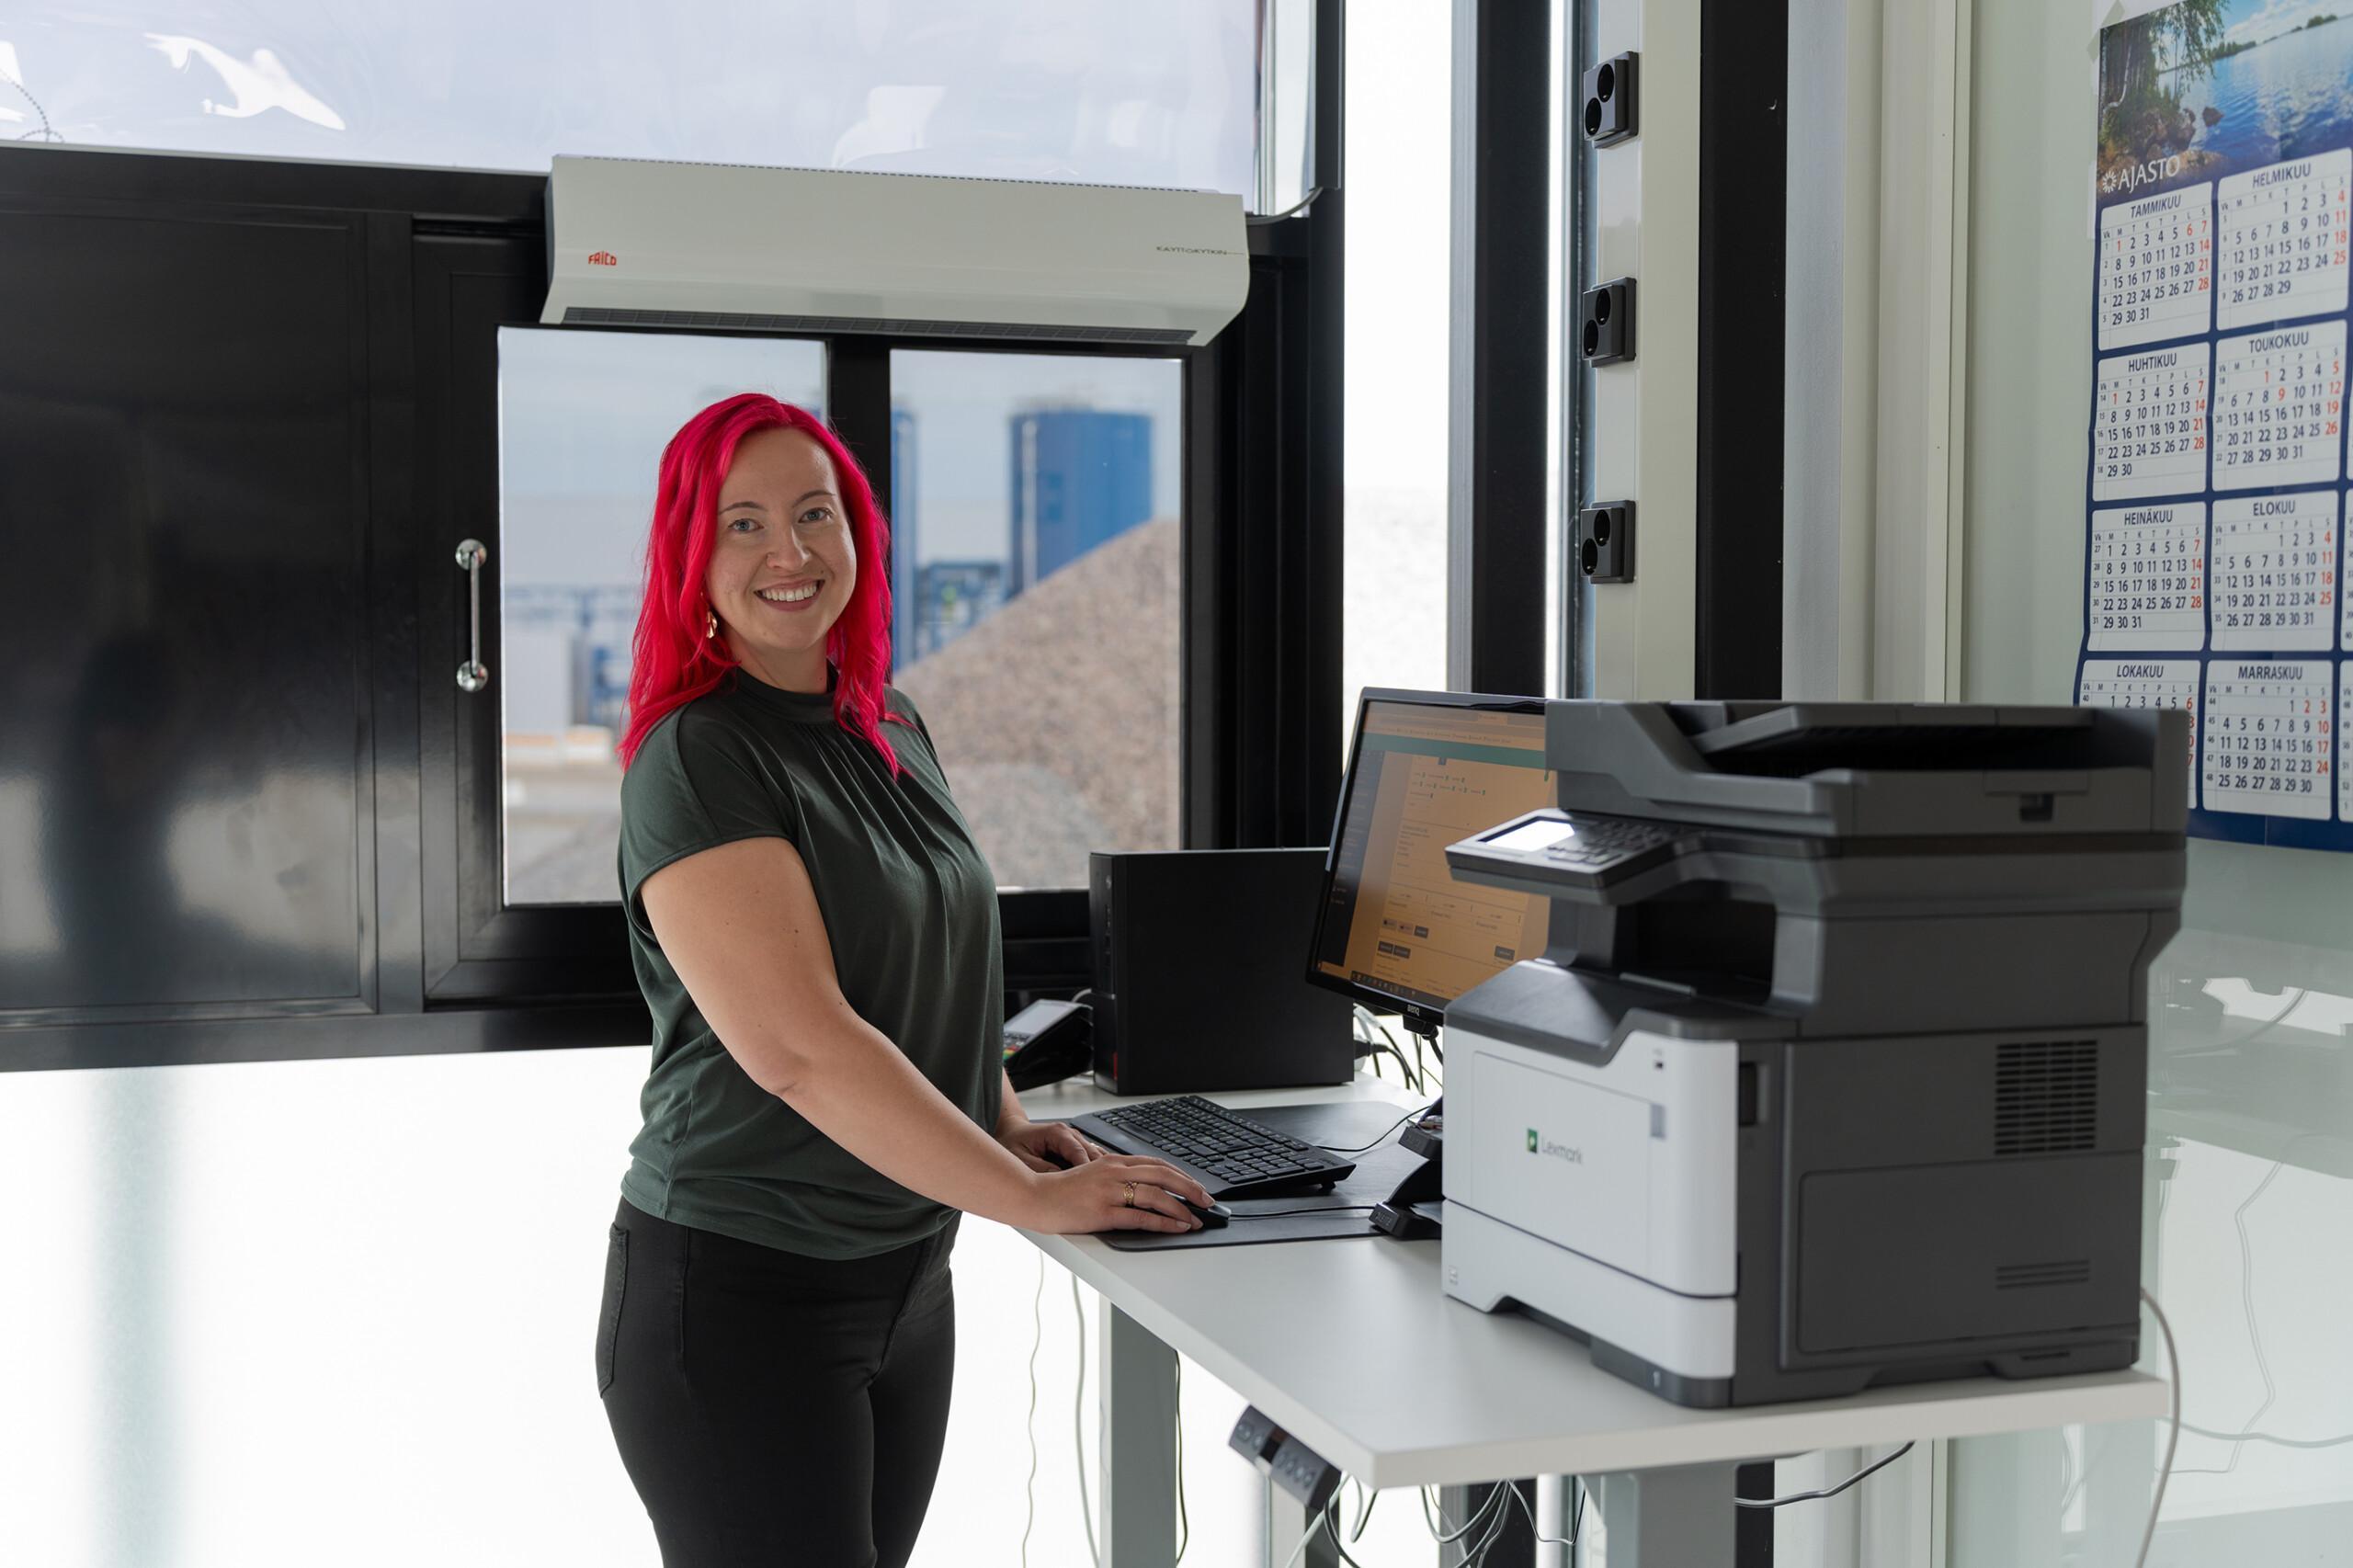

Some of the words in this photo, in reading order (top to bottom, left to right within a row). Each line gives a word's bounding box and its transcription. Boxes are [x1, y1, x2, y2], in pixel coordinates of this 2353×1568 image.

[2118, 154, 2179, 194] AJASTO
[2253, 163, 2311, 188] HELMIKUU
[2131, 195, 2180, 218] TAMMIKUU
[2118, 240, 2120, 252] 1
[2131, 237, 2135, 249] 2
[2144, 233, 2149, 246] 3
[2158, 231, 2164, 242] 4
[2173, 227, 2177, 240] 5
[2187, 223, 2193, 236] 6
[2202, 220, 2207, 233] 7
[2279, 240, 2291, 254] 15
[2299, 237, 2310, 250] 16
[2316, 233, 2328, 247] 17
[2335, 230, 2347, 244] 18
[2116, 258, 2121, 270] 8
[2130, 256, 2135, 267] 9
[2142, 252, 2152, 265] 10
[2156, 248, 2165, 261] 11
[2171, 245, 2180, 258] 12
[2185, 242, 2195, 256] 13
[2200, 239, 2210, 252] 14
[2114, 276, 2123, 289] 15
[2128, 273, 2137, 286] 16
[2142, 270, 2151, 283] 17
[2156, 267, 2165, 279] 18
[2170, 264, 2180, 277] 19
[2184, 261, 2195, 275] 20
[2199, 258, 2208, 272] 21
[2113, 294, 2122, 307] 22
[2127, 291, 2136, 304] 23
[2141, 289, 2151, 301] 24
[2154, 286, 2165, 299] 25
[2169, 283, 2179, 296] 26
[2184, 279, 2194, 293] 27
[2199, 277, 2209, 290] 28
[2112, 312, 2122, 325] 29
[2126, 310, 2136, 323] 30
[2140, 307, 2149, 320] 31
[2249, 332, 2309, 353] TOUKOKUU
[2129, 353, 2177, 372] HUHTIKUU
[2113, 393, 2117, 404] 1
[2126, 391, 2131, 403] 2
[2141, 389, 2145, 401] 3
[2154, 387, 2160, 398] 4
[2169, 384, 2174, 397] 5
[2183, 382, 2188, 395] 6
[2199, 381, 2204, 392] 7
[2111, 411, 2116, 423] 8
[2125, 409, 2131, 421] 9
[2138, 407, 2147, 419] 10
[2152, 405, 2160, 417] 11
[2166, 403, 2176, 415] 12
[2181, 401, 2190, 414] 13
[2196, 399, 2205, 412] 14
[2109, 428, 2118, 441] 15
[2122, 426, 2132, 439] 16
[2136, 425, 2145, 437] 17
[2150, 423, 2160, 436] 18
[2165, 421, 2175, 434] 19
[2178, 419, 2189, 432] 20
[2193, 417, 2202, 431] 21
[2228, 432, 2238, 446] 20
[2243, 431, 2252, 444] 21
[2258, 429, 2270, 442] 22
[2277, 426, 2287, 440] 23
[2293, 425, 2304, 438] 24
[2309, 423, 2320, 437] 25
[2325, 421, 2337, 435] 26
[2109, 447, 2118, 459] 22
[2122, 445, 2131, 458] 23
[2136, 444, 2146, 456] 24
[2151, 441, 2160, 454] 25
[2165, 440, 2175, 453] 26
[2179, 438, 2189, 451] 27
[2194, 437, 2204, 449] 28
[2108, 465, 2118, 477] 29
[2121, 463, 2131, 476] 30
[2125, 508, 2173, 525] HEINÄKUU
[2253, 500, 2296, 517] ELOKUU
[2109, 545, 2111, 557] 1
[2121, 544, 2127, 556] 2
[2136, 543, 2141, 555] 3
[2150, 542, 2155, 553] 4
[2165, 541, 2170, 553] 5
[2179, 540, 2185, 552] 6
[2195, 539, 2200, 551] 7
[2107, 562, 2112, 574] 8
[2120, 562, 2126, 574] 9
[2133, 561, 2143, 574] 10
[2147, 561, 2156, 573] 11
[2162, 560, 2172, 572] 12
[2177, 559, 2187, 572] 13
[2192, 559, 2202, 571] 14
[2105, 581, 2114, 593] 15
[2119, 580, 2128, 592] 16
[2132, 579, 2143, 591] 17
[2147, 579, 2156, 591] 18
[2162, 578, 2171, 590] 19
[2176, 577, 2187, 590] 20
[2191, 577, 2200, 590] 21
[2104, 598, 2113, 610] 22
[2118, 598, 2127, 610] 23
[2131, 597, 2142, 609] 24
[2146, 597, 2156, 609] 25
[2161, 597, 2171, 609] 26
[2176, 597, 2186, 608] 27
[2191, 596, 2201, 608] 28
[2227, 595, 2237, 607] 19
[2243, 594, 2254, 607] 20
[2259, 594, 2269, 607] 21
[2276, 593, 2285, 607] 22
[2290, 592, 2300, 606] 23
[2304, 592, 2315, 605] 24
[2320, 591, 2331, 605] 25
[2104, 617, 2113, 629] 29
[2118, 616, 2128, 629] 30
[2132, 616, 2142, 628] 31
[2117, 665, 2164, 678] LOKAKUU
[2238, 666, 2302, 680] MARRASKUU
[2111, 696, 2116, 708] 1
[2125, 696, 2131, 708] 2
[2140, 696, 2146, 709] 3
[2155, 697, 2162, 709] 4
[2171, 697, 2177, 710] 5
[2187, 697, 2193, 710] 6
[2221, 736, 2231, 748] 11
[2237, 737, 2248, 750] 12
[2255, 738, 2267, 751] 13
[2272, 739, 2281, 751] 14
[2287, 739, 2297, 753] 15
[2302, 740, 2313, 753] 16
[2318, 740, 2329, 754] 17
[2221, 756, 2231, 768] 18
[2237, 756, 2248, 769] 19
[2253, 757, 2266, 770] 20
[2270, 757, 2279, 771] 21
[2286, 758, 2296, 772] 22
[2301, 759, 2312, 773] 23
[2316, 760, 2328, 774] 24
[2219, 774, 2230, 787] 25
[2235, 775, 2247, 789] 26
[2252, 776, 2265, 789] 27
[2270, 778, 2280, 790] 28
[2285, 778, 2296, 791] 29
[2301, 779, 2312, 792] 30
[1541, 1136, 1583, 1165] Lexmark
